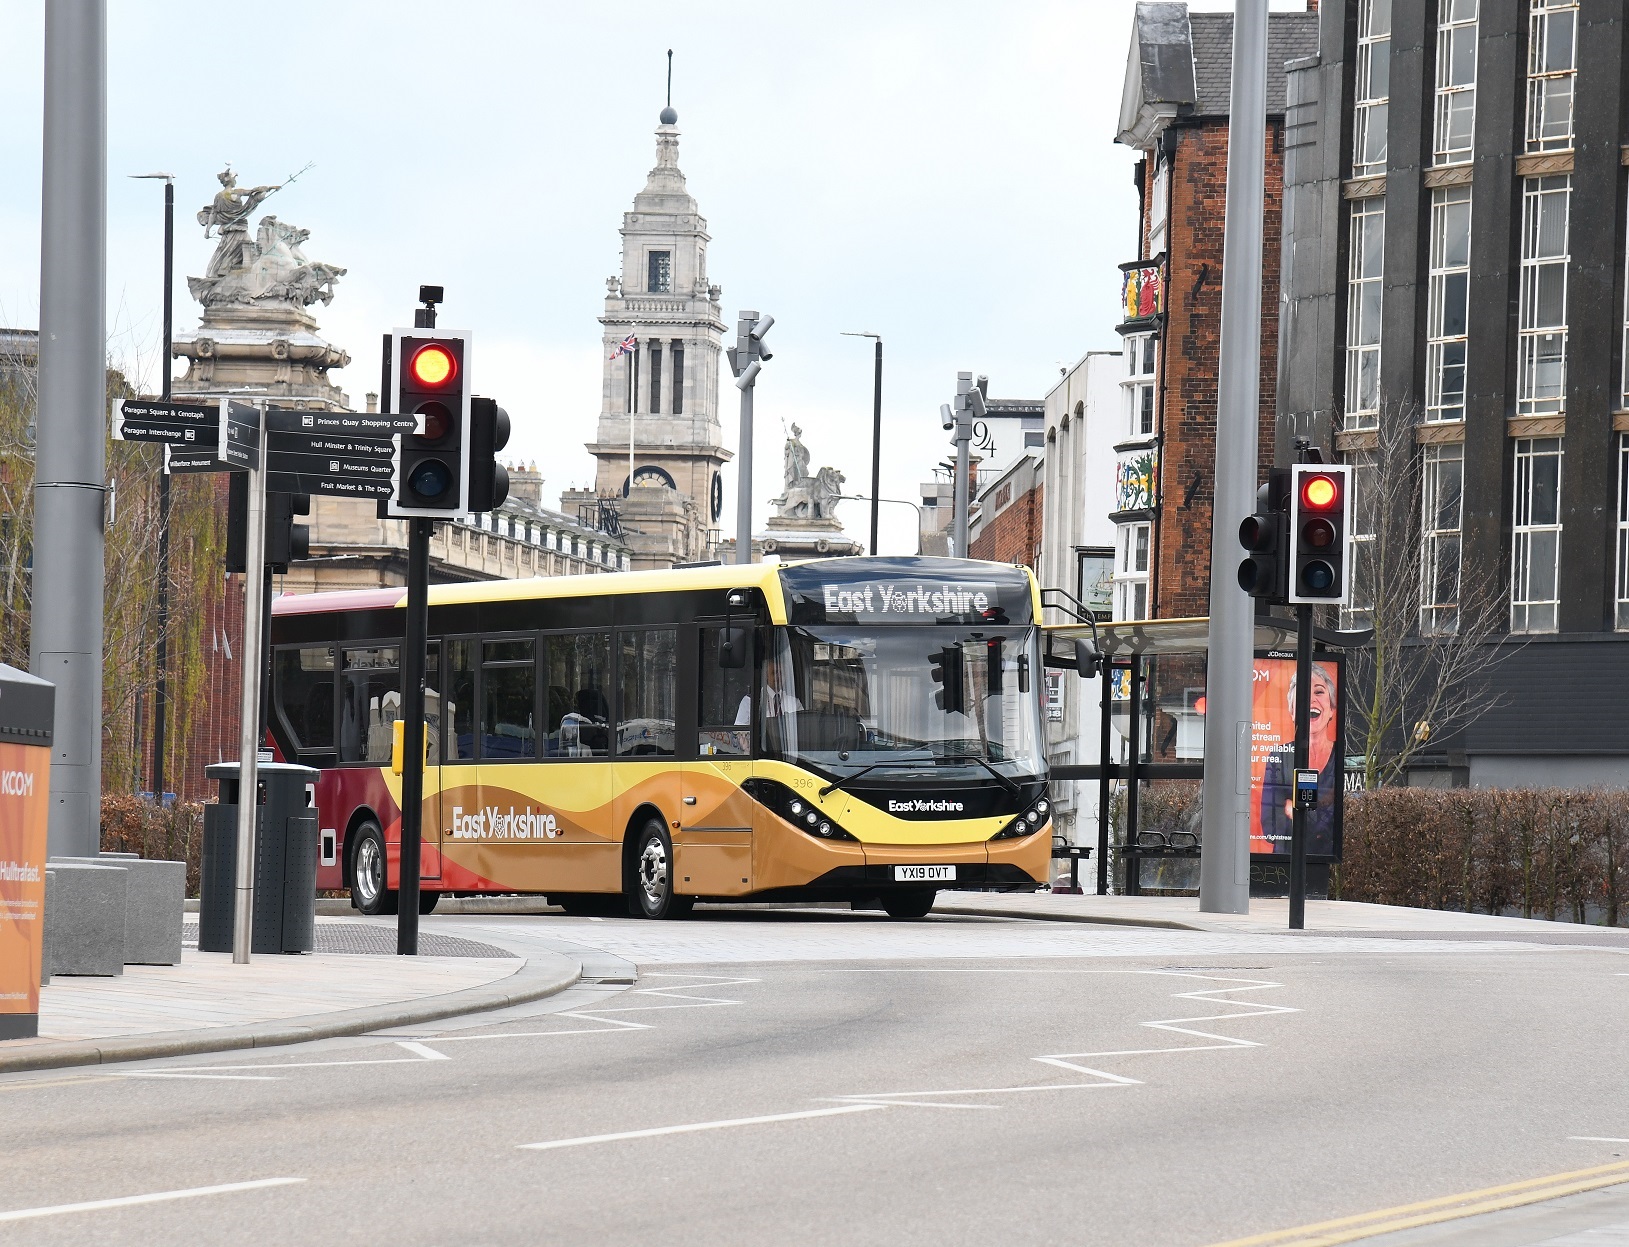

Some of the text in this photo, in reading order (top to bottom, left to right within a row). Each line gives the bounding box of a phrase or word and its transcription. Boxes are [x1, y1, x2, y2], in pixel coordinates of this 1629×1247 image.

[124, 406, 148, 414] Paragon
[149, 409, 169, 417] Square
[177, 411, 205, 419] Cenotaph
[317, 418, 340, 426] Princes
[342, 419, 359, 427] Quay
[361, 420, 391, 428] Shopping
[123, 427, 147, 436] Paragon
[148, 429, 182, 438] Interchange
[354, 444, 373, 452] Trinity
[343, 463, 392, 473] Museums Quarter
[335, 483, 356, 491] Market
[824, 584, 874, 613] East
[1259, 743, 1295, 753] available
[1261, 754, 1283, 763] area.
[1, 770, 34, 797] KCOM
[793, 778, 814, 789] 396
[888, 799, 963, 812] East Yorkshire
[452, 805, 557, 839] East Yorkshire
[0, 860, 41, 882] Hulltrafast.
[901, 867, 949, 879] YX19 OVT
